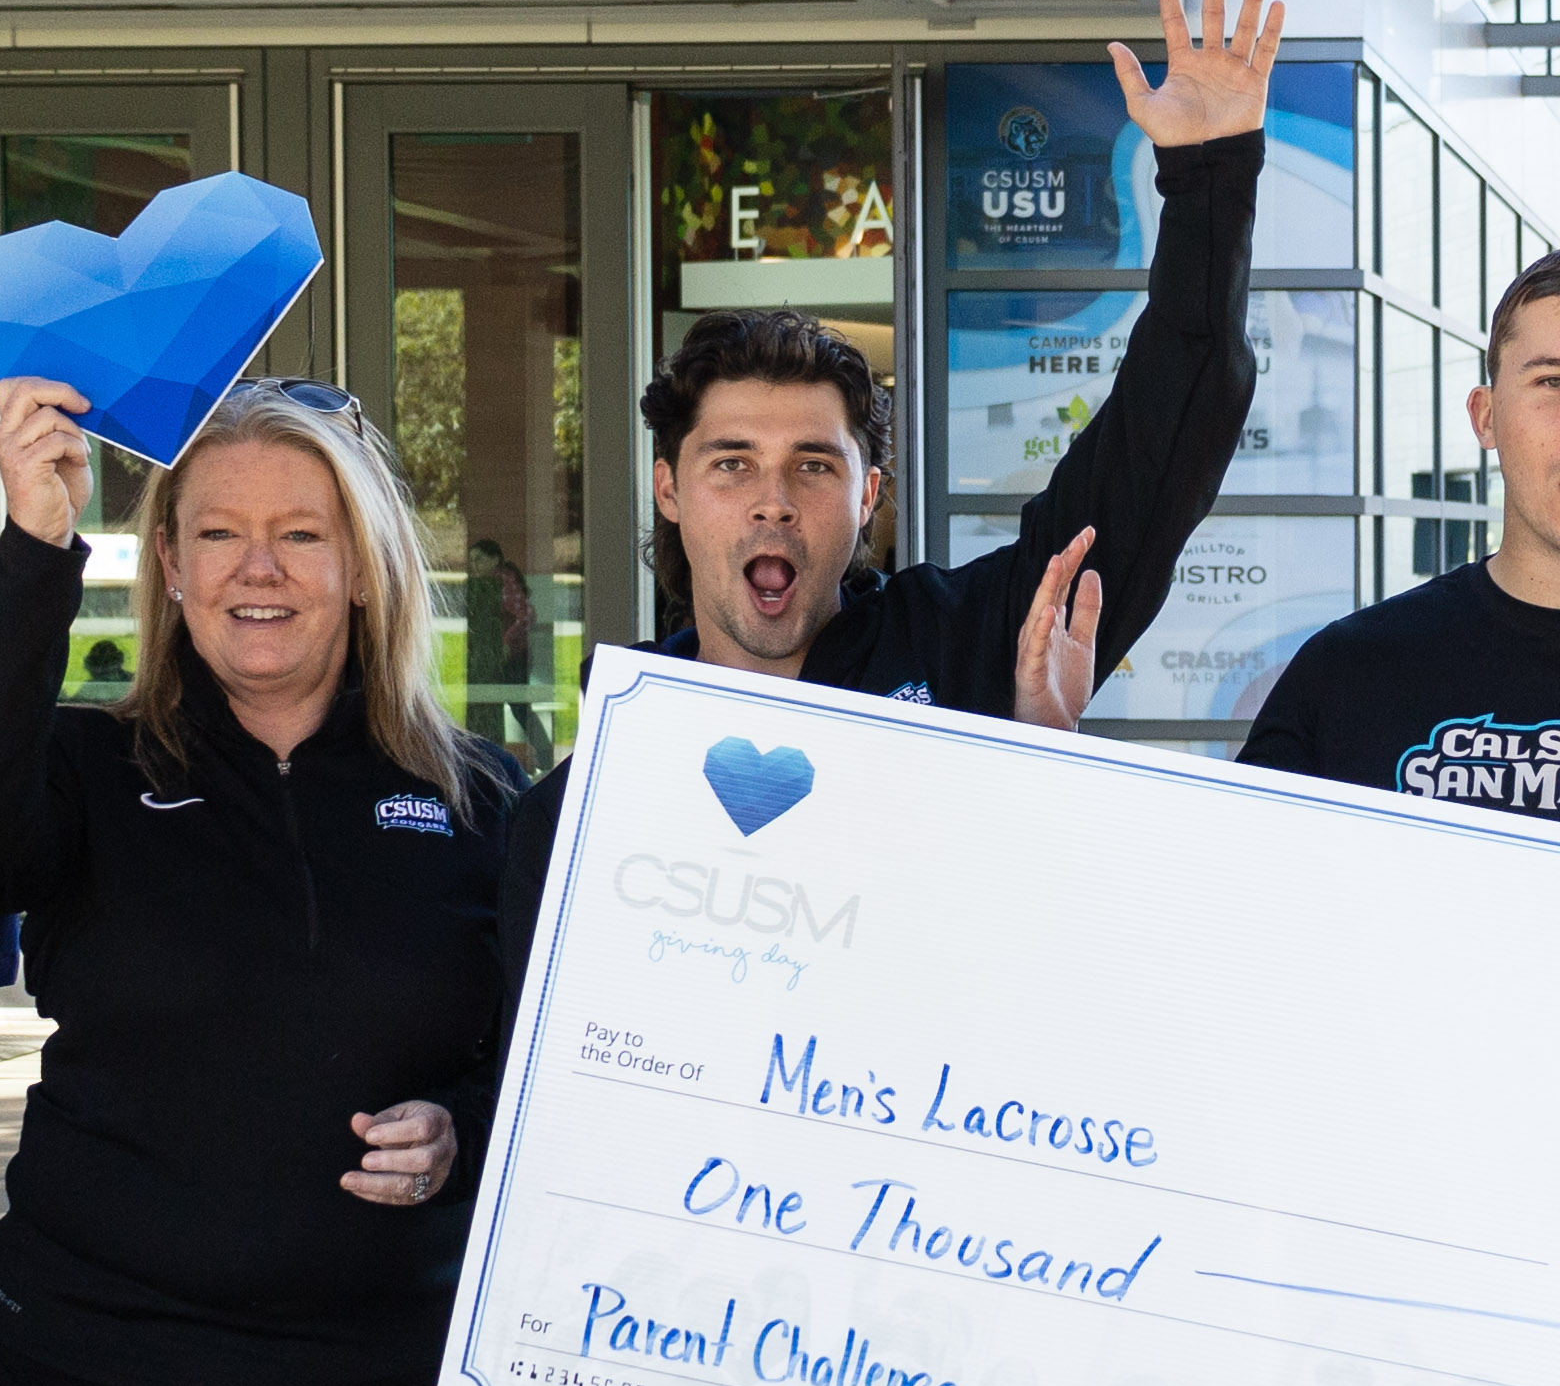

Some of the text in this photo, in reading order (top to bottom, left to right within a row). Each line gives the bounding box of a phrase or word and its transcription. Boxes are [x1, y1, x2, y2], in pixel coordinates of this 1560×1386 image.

[983, 170, 1065, 188] CSUSM
[983, 190, 1065, 218] USU
[984, 224, 1063, 232] THE HEARTBEAT
[999, 236, 1049, 244] OF CSUSM
[1028, 336, 1104, 350] CAMPUS
[1028, 355, 1101, 374] HERE
[1023, 435, 1061, 462] get
[1184, 544, 1246, 556] HILLTOP
[1187, 594, 1243, 605] GRILLE
[1160, 650, 1267, 670] CRASH'S
[1172, 673, 1255, 684] MARKET
[1442, 728, 1531, 760] CAL
[1405, 754, 1506, 800] SAN
[380, 801, 447, 823] CSUSM
[614, 853, 861, 948] CSUSM
[648, 930, 809, 990] giving day
[585, 1021, 644, 1048] Pay to
[580, 1044, 705, 1081] the Order Of
[760, 1033, 896, 1125] Men's
[683, 1157, 1162, 1303] One Thousand
[520, 1314, 552, 1335] For
[581, 1283, 736, 1369] Parent
